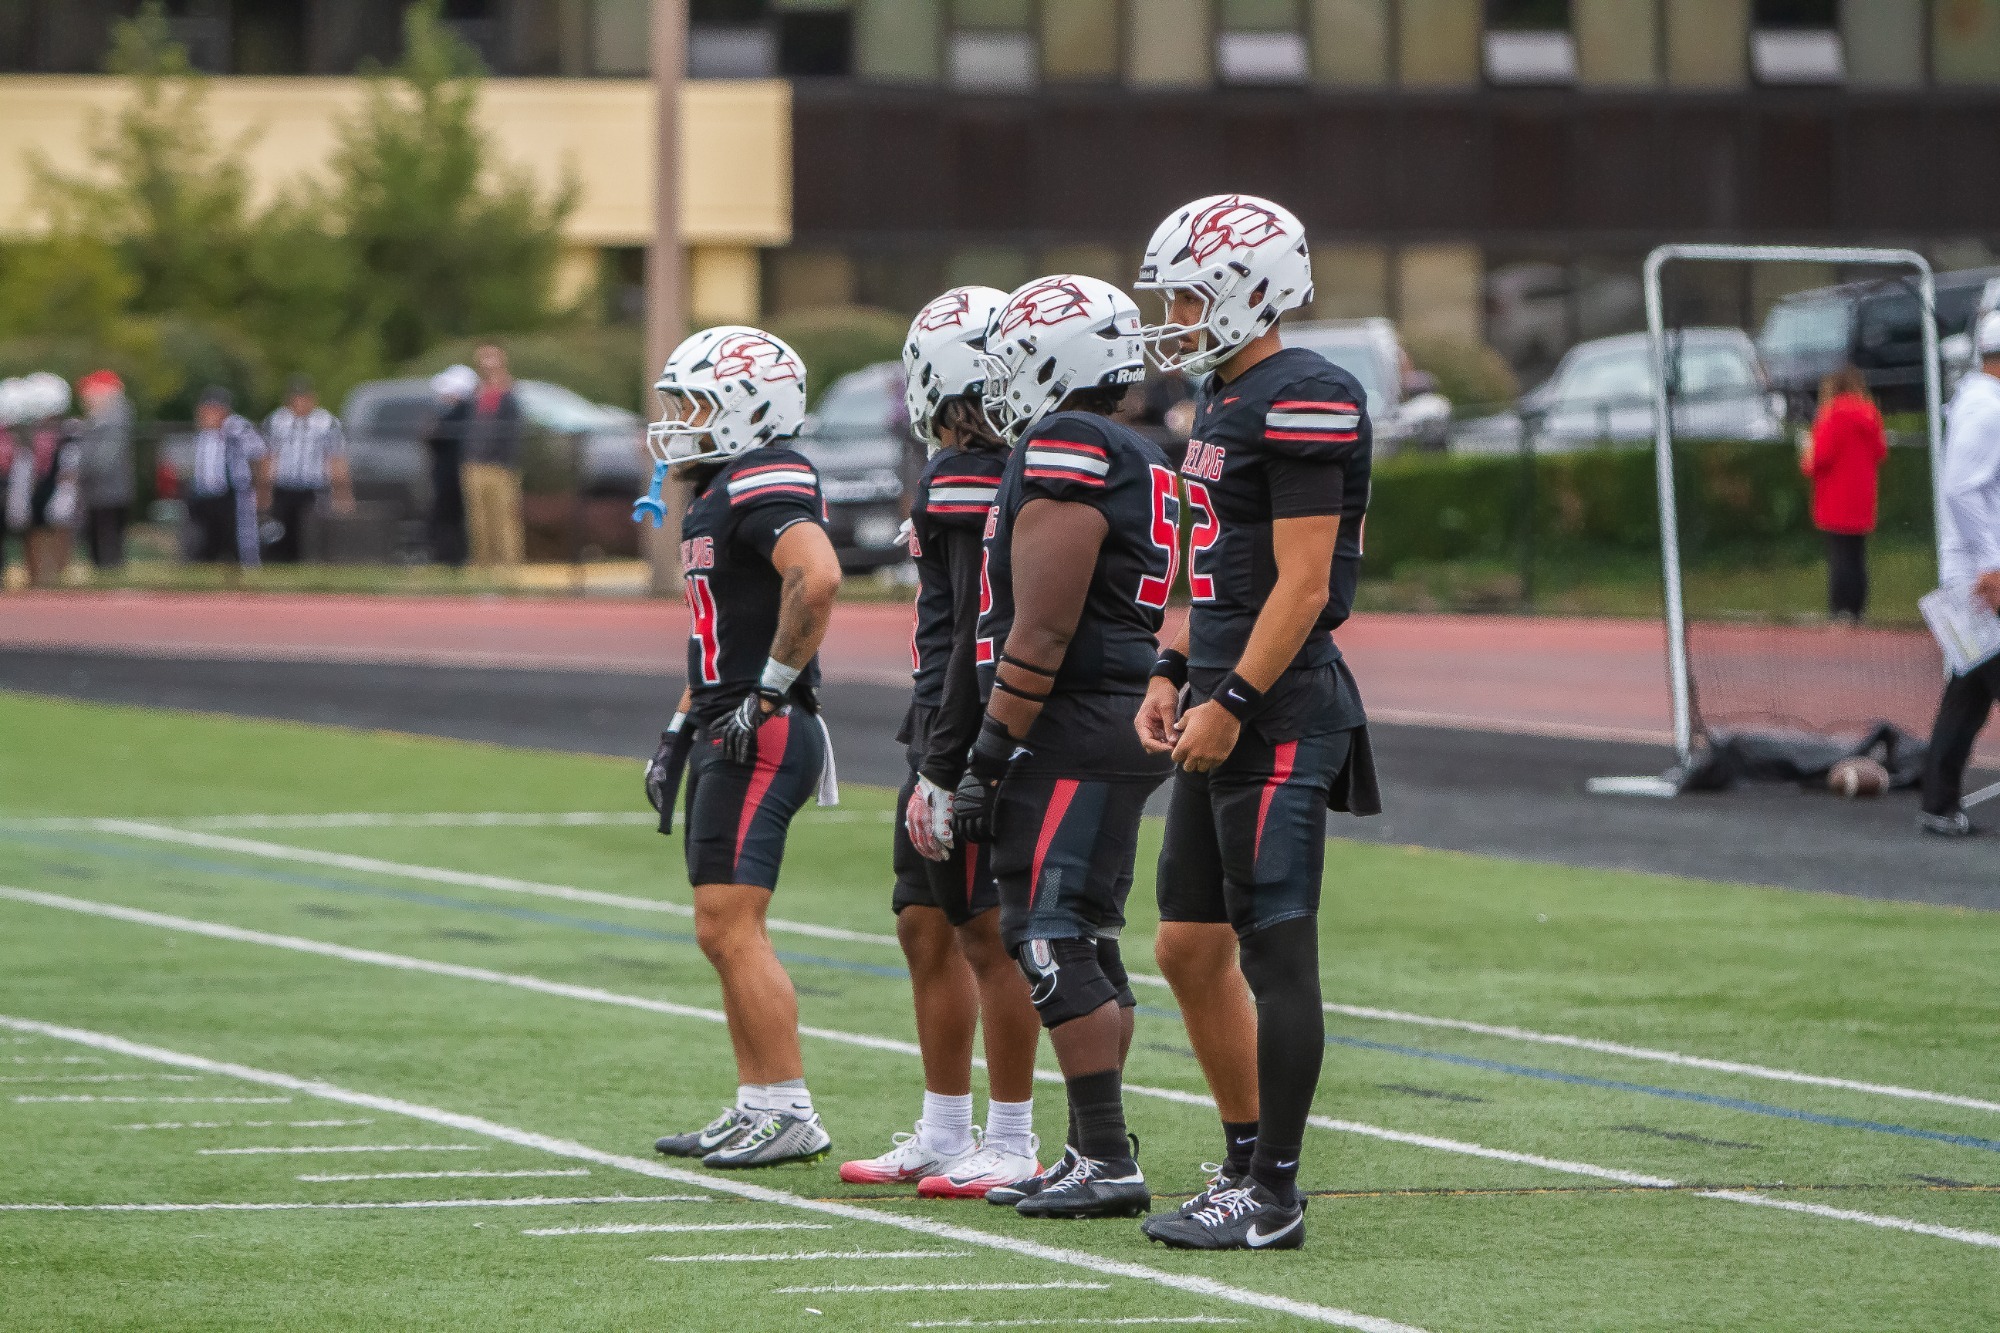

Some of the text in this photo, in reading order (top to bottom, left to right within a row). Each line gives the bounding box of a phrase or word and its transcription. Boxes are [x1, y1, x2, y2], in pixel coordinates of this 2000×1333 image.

[1117, 367, 1146, 384] Ridd
[1135, 463, 1180, 610] 5
[1184, 479, 1220, 601] 2
[685, 574, 720, 684] 4
